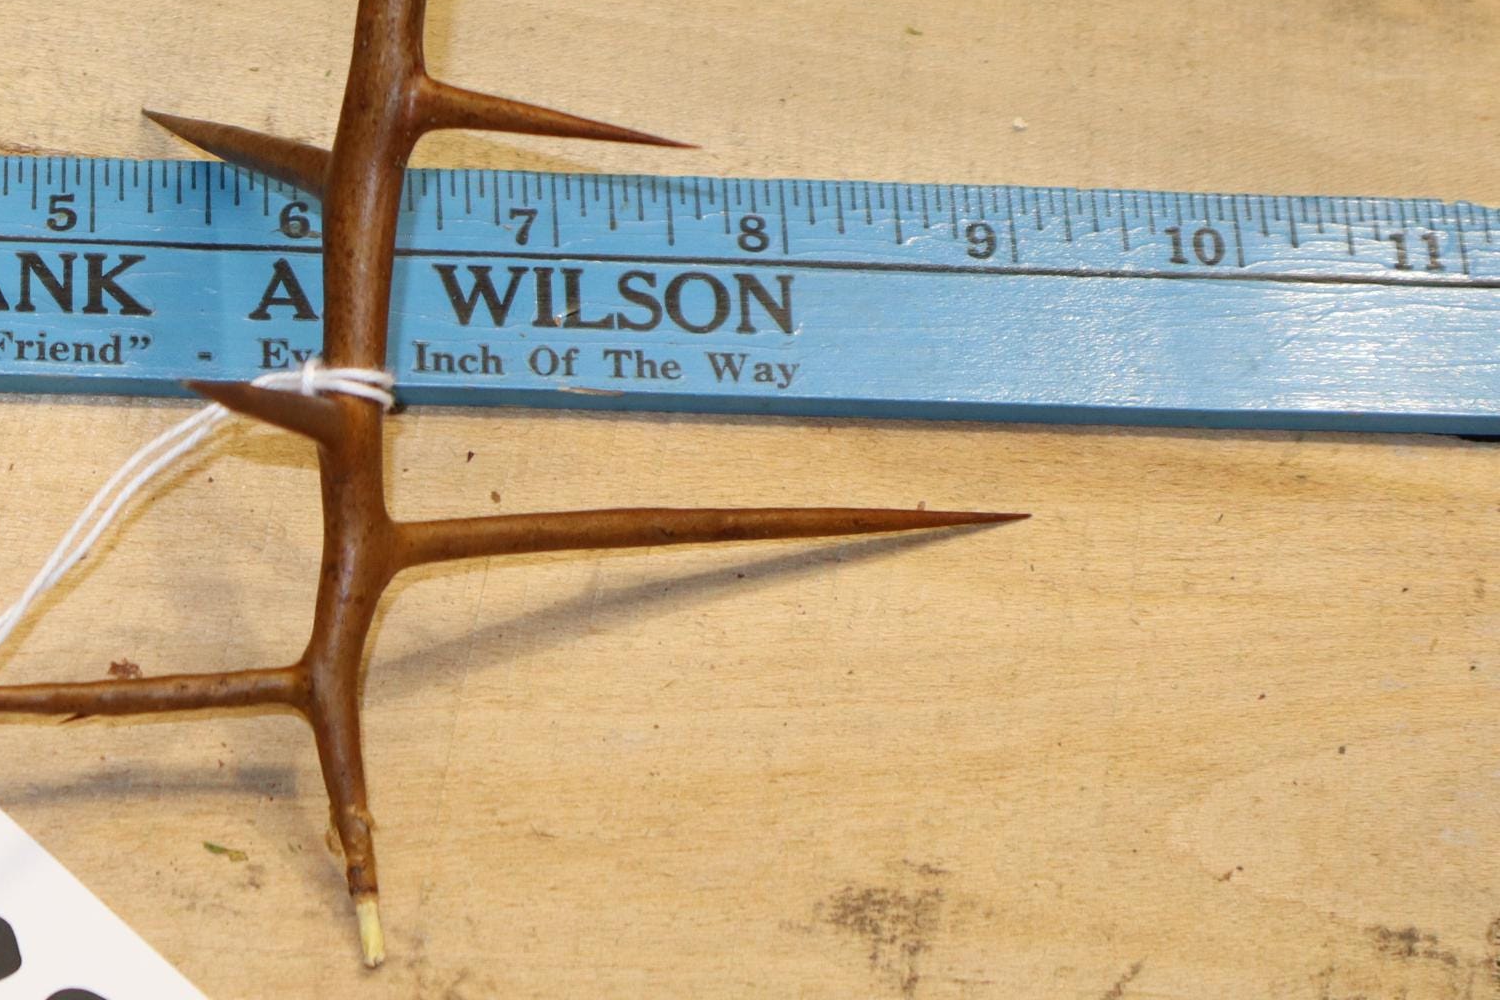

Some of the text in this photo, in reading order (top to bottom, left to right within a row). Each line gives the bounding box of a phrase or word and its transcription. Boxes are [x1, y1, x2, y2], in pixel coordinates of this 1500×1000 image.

[46, 193, 78, 232] 5
[279, 201, 311, 239] 6
[509, 208, 539, 246] 7
[737, 214, 769, 253] 8
[965, 222, 998, 260] 9
[1165, 227, 1226, 266] 10
[1388, 233, 1446, 271] 11
[432, 263, 795, 335] WILSON
[412, 341, 505, 376] Inch
[529, 346, 580, 378] Of
[604, 349, 682, 381] The
[707, 352, 801, 389] Way
